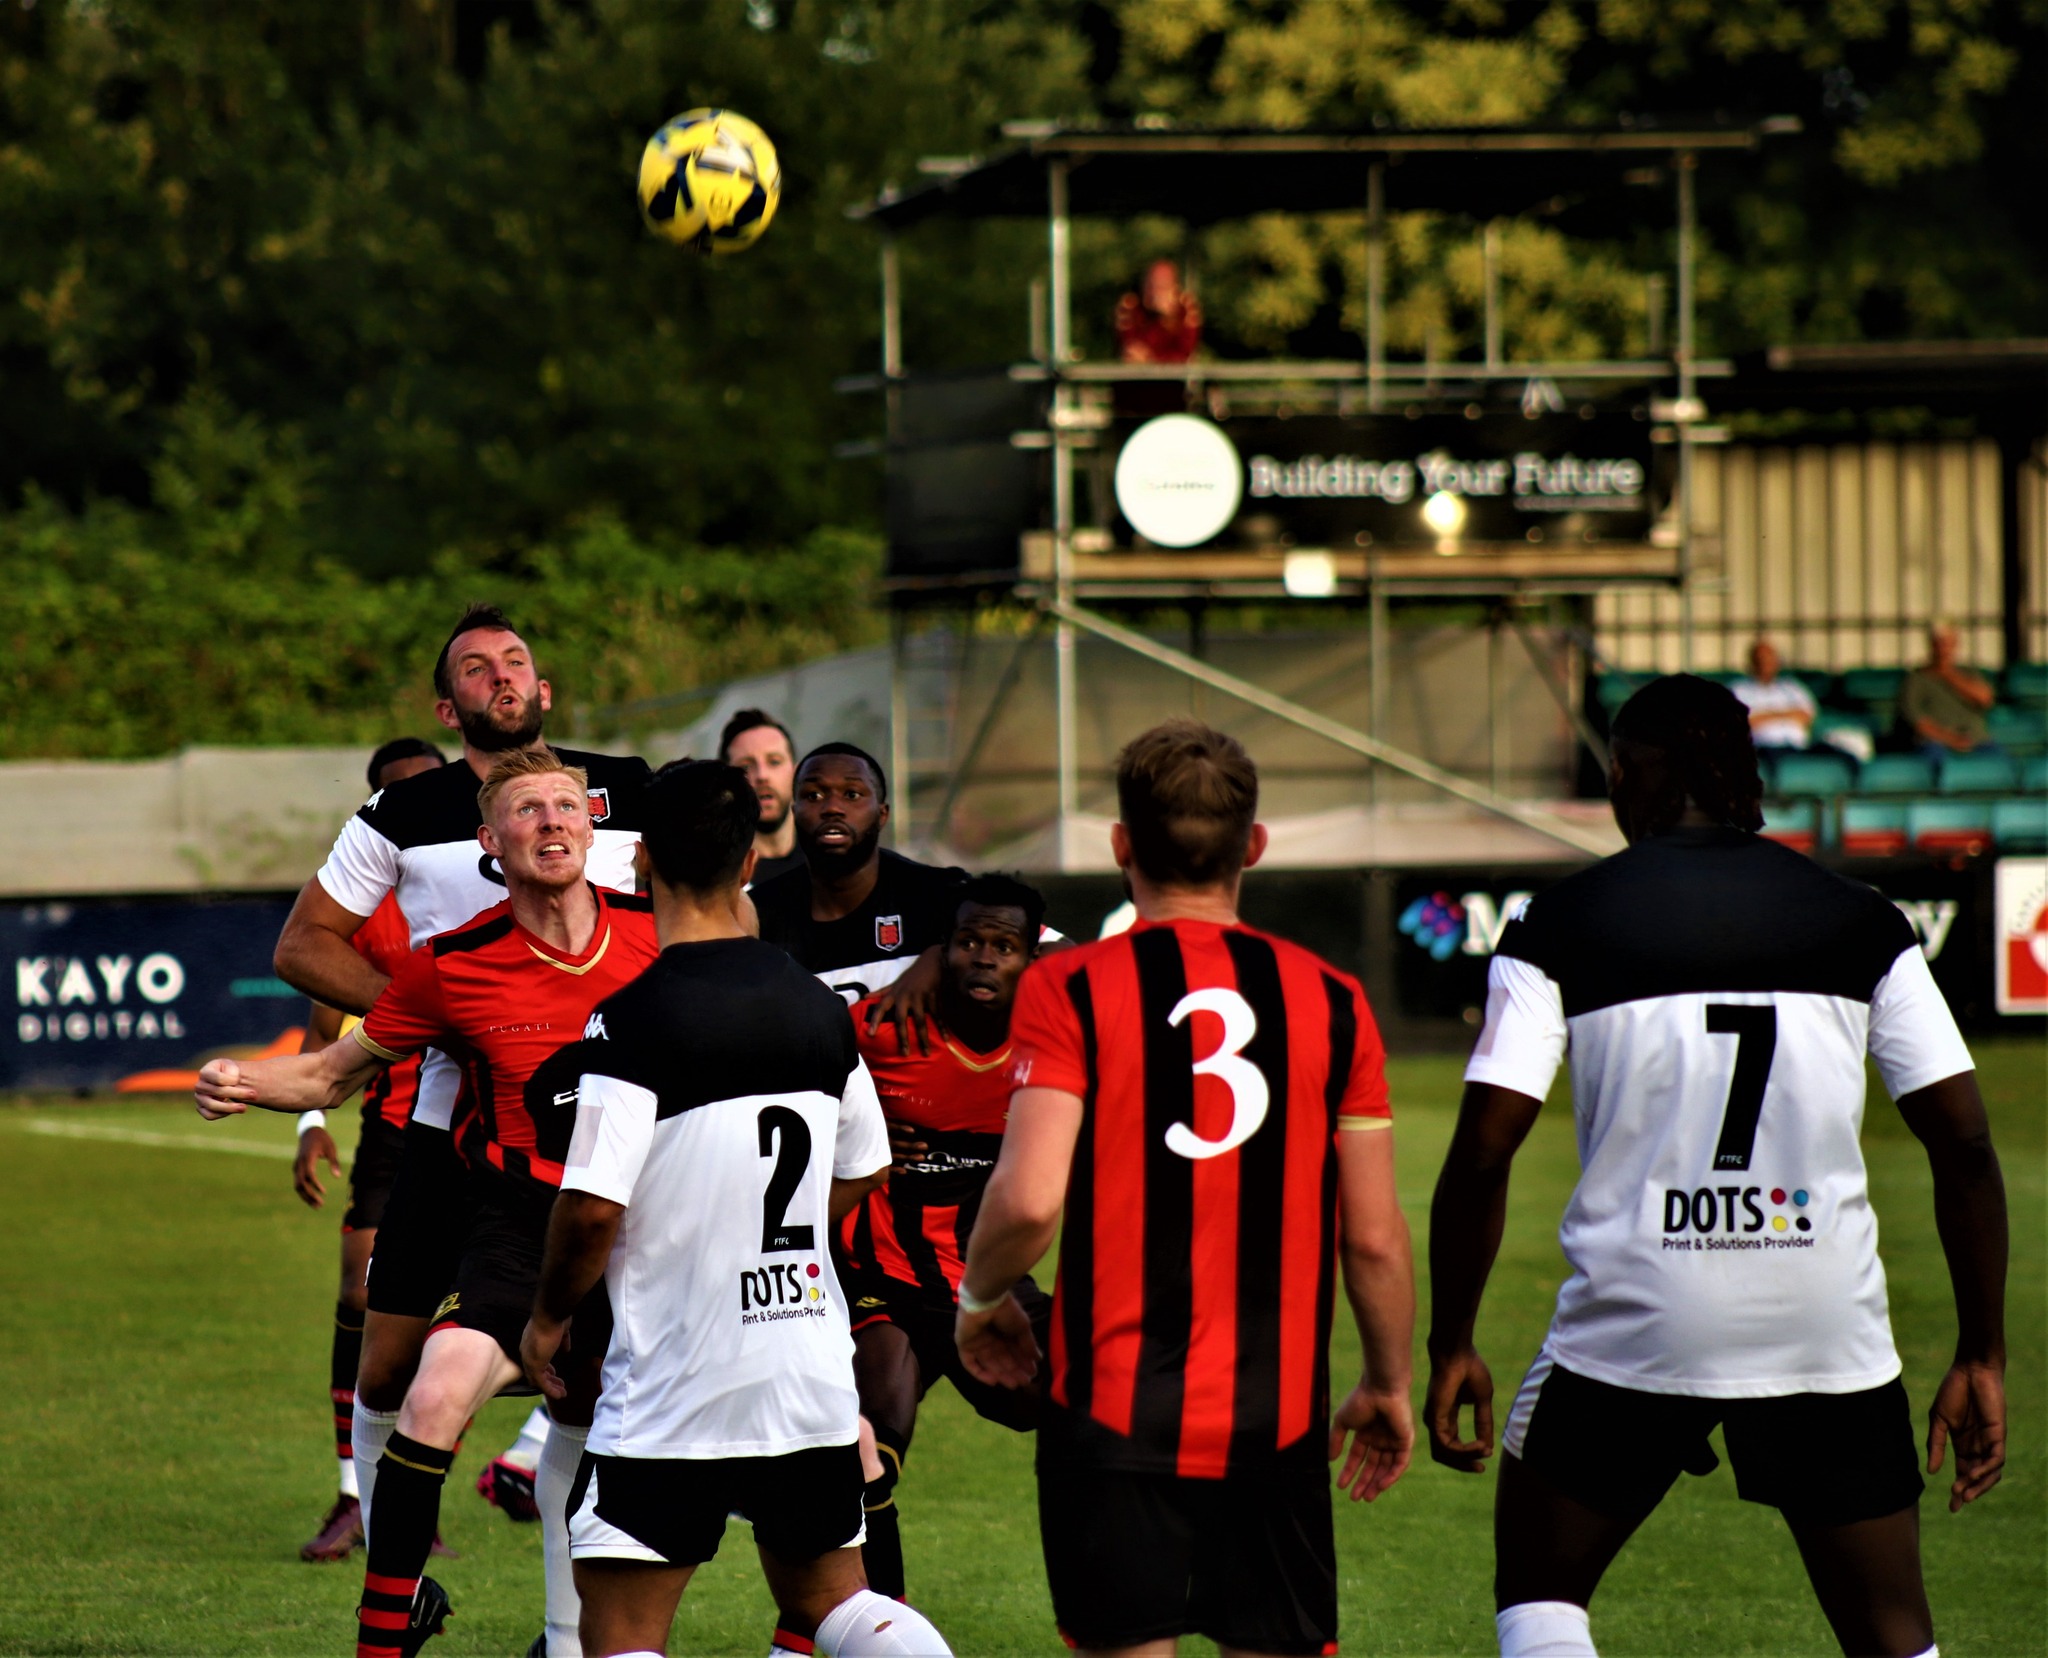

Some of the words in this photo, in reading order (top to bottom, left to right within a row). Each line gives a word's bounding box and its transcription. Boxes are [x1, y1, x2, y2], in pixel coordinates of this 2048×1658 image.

[1250, 455, 1414, 503] Building
[1417, 450, 1508, 495] Your
[1514, 452, 1644, 495] Future
[17, 953, 185, 1005] KAYO
[18, 1011, 186, 1041] DIGITAL
[1165, 988, 1270, 1160] 3
[1706, 1004, 1777, 1171] 7
[757, 1105, 814, 1253] 2
[1664, 1187, 1765, 1233] DOTS
[1662, 1238, 1692, 1251] Print
[1694, 1238, 1703, 1250] &
[1705, 1237, 1762, 1250] Solutions
[1764, 1236, 1814, 1248] Provider
[740, 1263, 803, 1311] DOTS
[767, 1308, 804, 1321] Solutions
